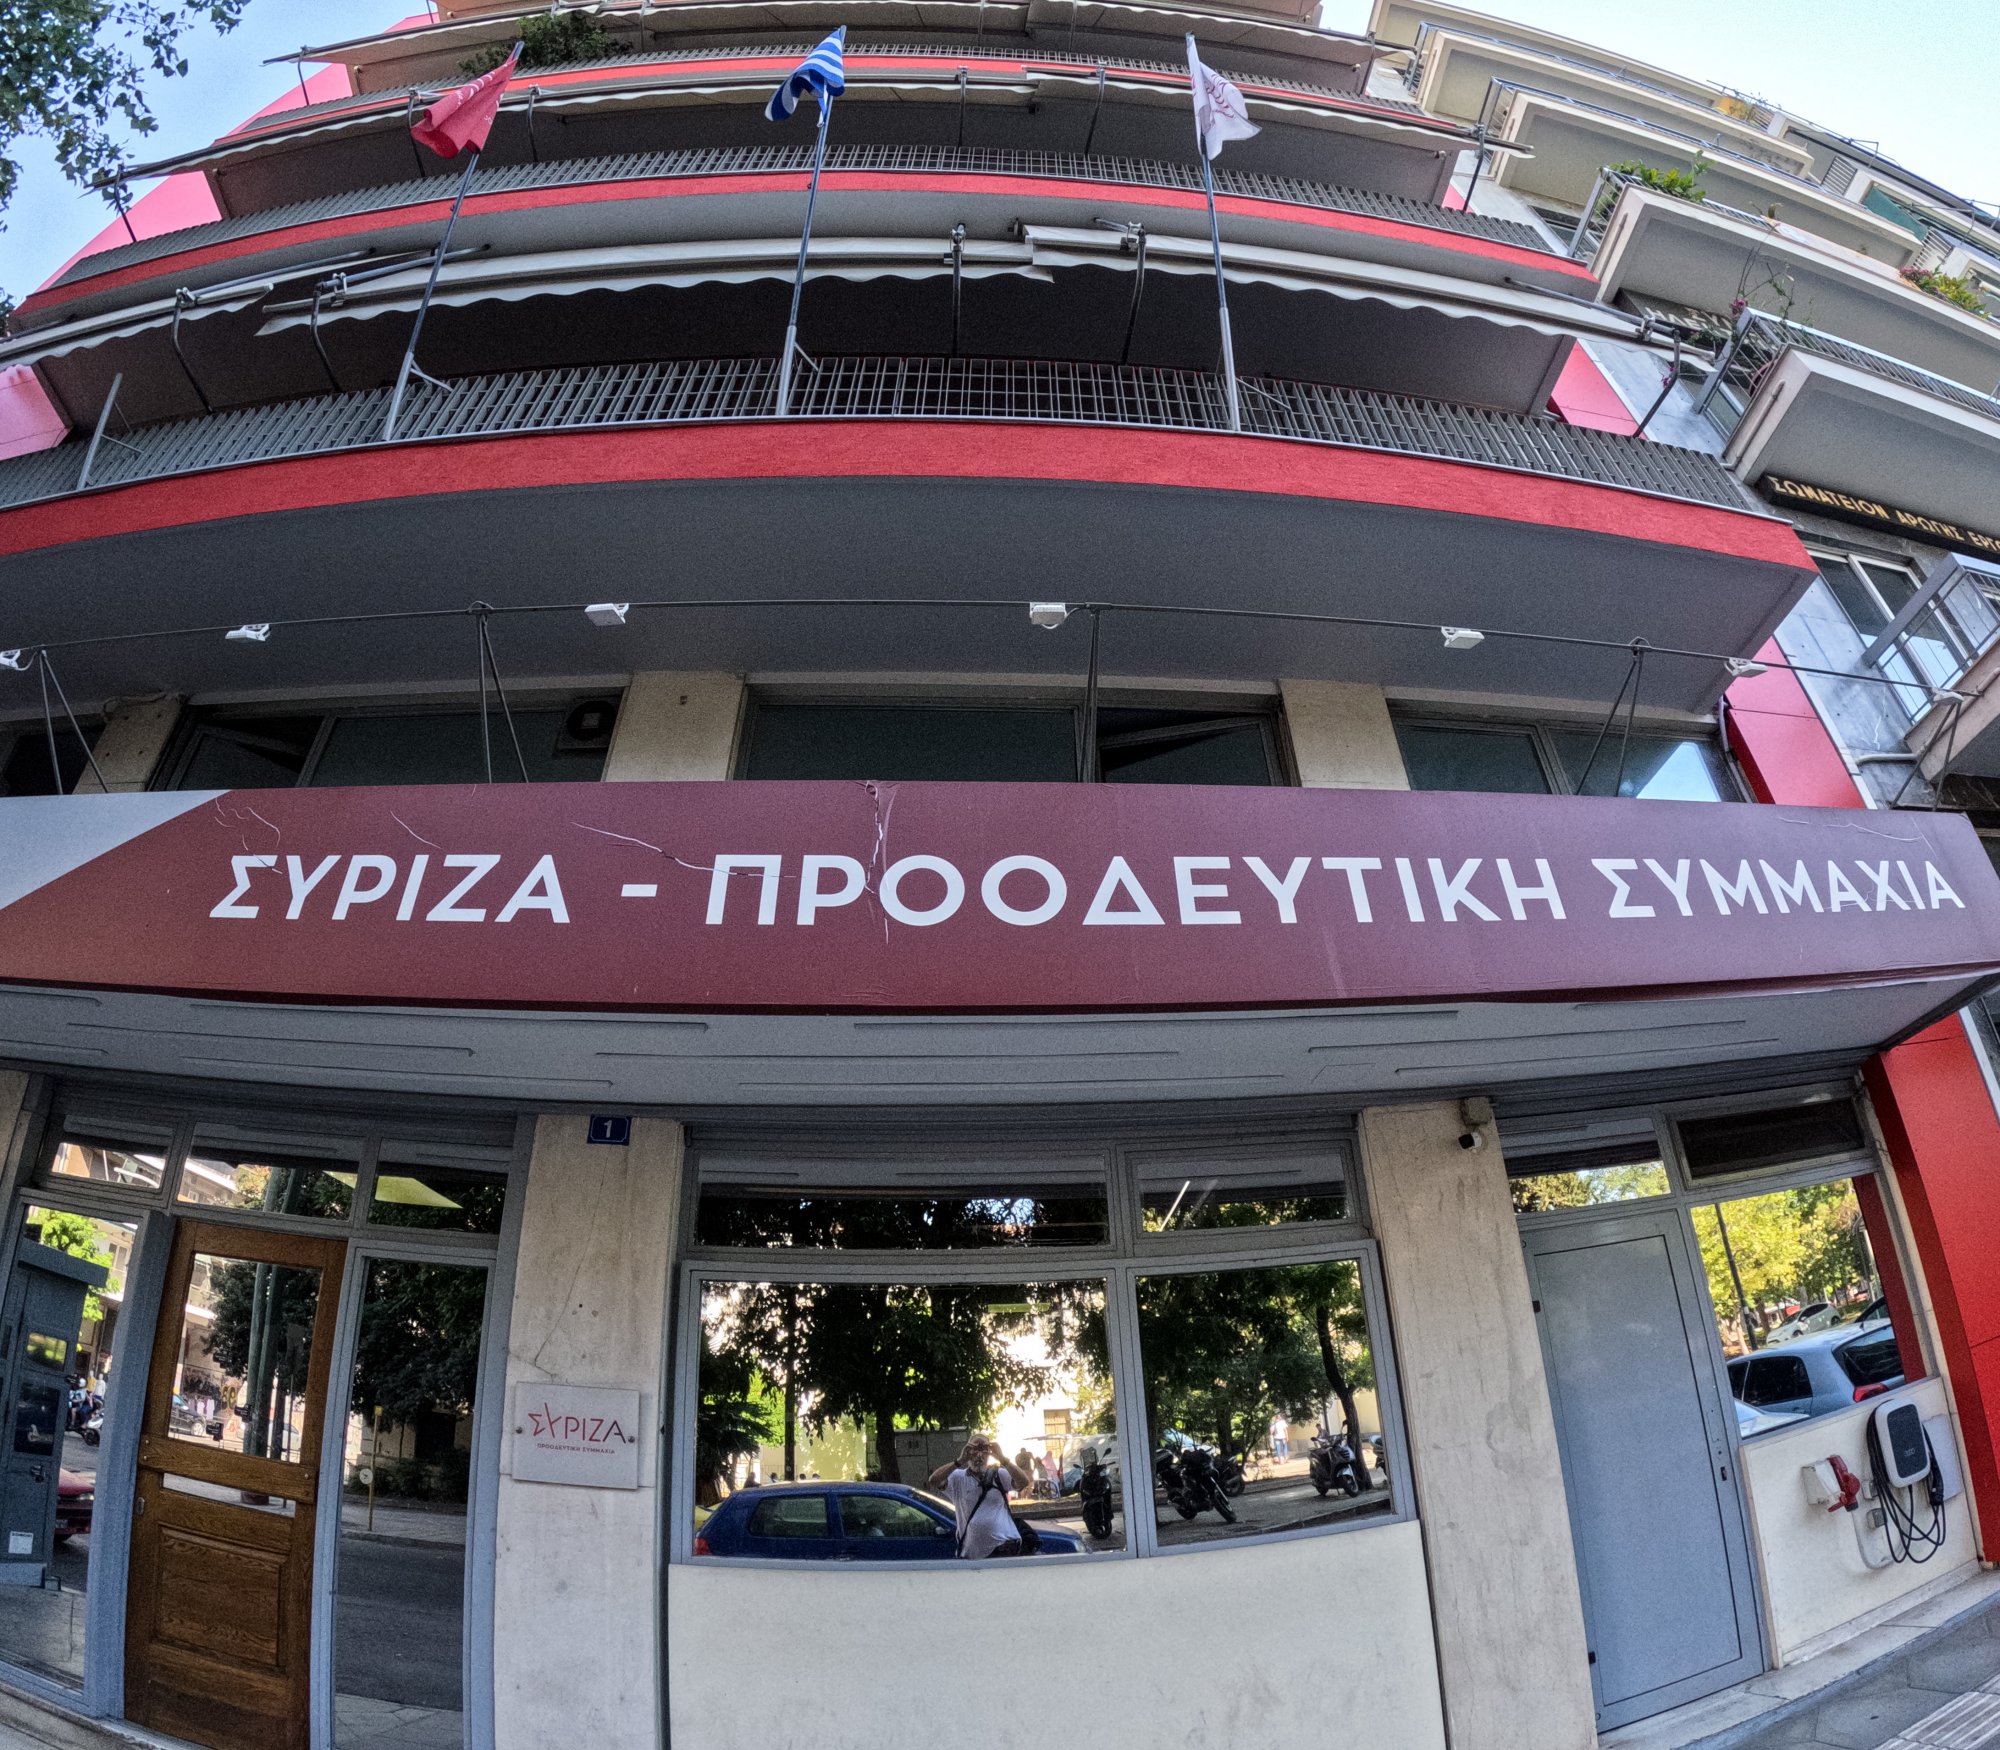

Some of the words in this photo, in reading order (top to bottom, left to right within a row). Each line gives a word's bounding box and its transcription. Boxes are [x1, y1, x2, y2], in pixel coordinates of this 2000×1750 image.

[1766, 475, 1890, 520] ΣΩΜΑΤΕΙΟΝ
[1895, 510, 1965, 541] ΑΡΩΓΗΣ
[210, 854, 570, 924] ΣΥΡΙΖΑ
[621, 884, 658, 897] -
[705, 853, 1567, 928] ΠΡΟΟΔΕΥΤΙΚΗ
[1590, 857, 1966, 919] ΣΥΜΜΑΧΙΑ
[603, 1119, 613, 1139] 1
[527, 1402, 627, 1444] ΣΥΡΙΖΑ
[536, 1442, 581, 1452] ΠΡΟΟΔΕΥΤΙΚΗ
[582, 1446, 616, 1455] ΣΥΜΜΑΧΙΑ
